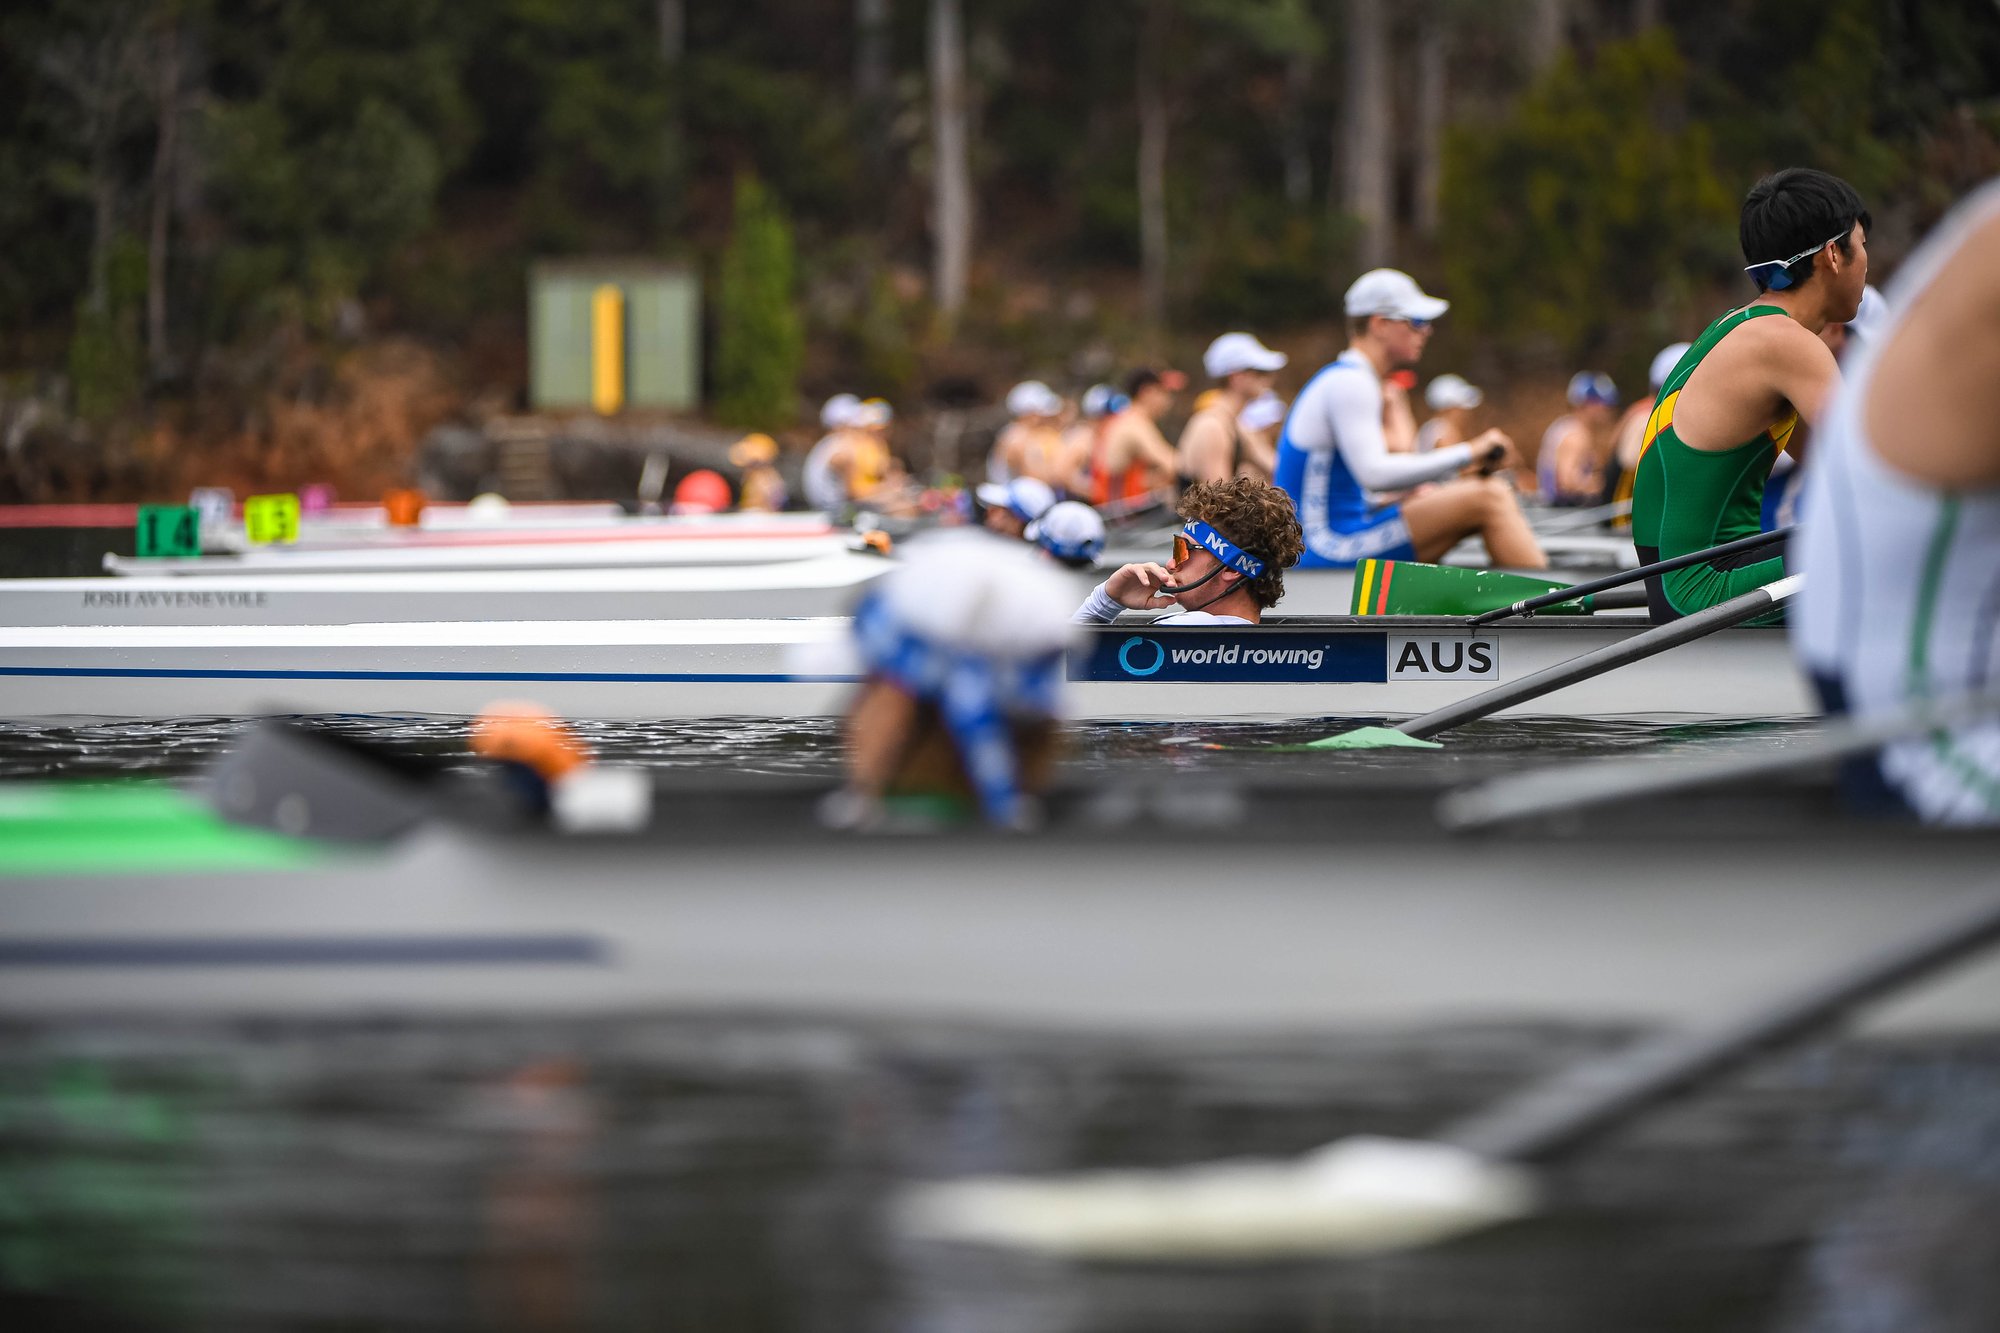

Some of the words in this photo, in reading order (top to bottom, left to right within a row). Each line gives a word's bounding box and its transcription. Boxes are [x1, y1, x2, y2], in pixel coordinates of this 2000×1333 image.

[146, 511, 195, 549] 14
[1205, 532, 1229, 556] NK
[1235, 555, 1262, 575] NK
[82, 591, 130, 608] JOSH
[1172, 645, 1240, 664] world
[1243, 649, 1324, 670] rowing
[1395, 641, 1492, 673] AUS
